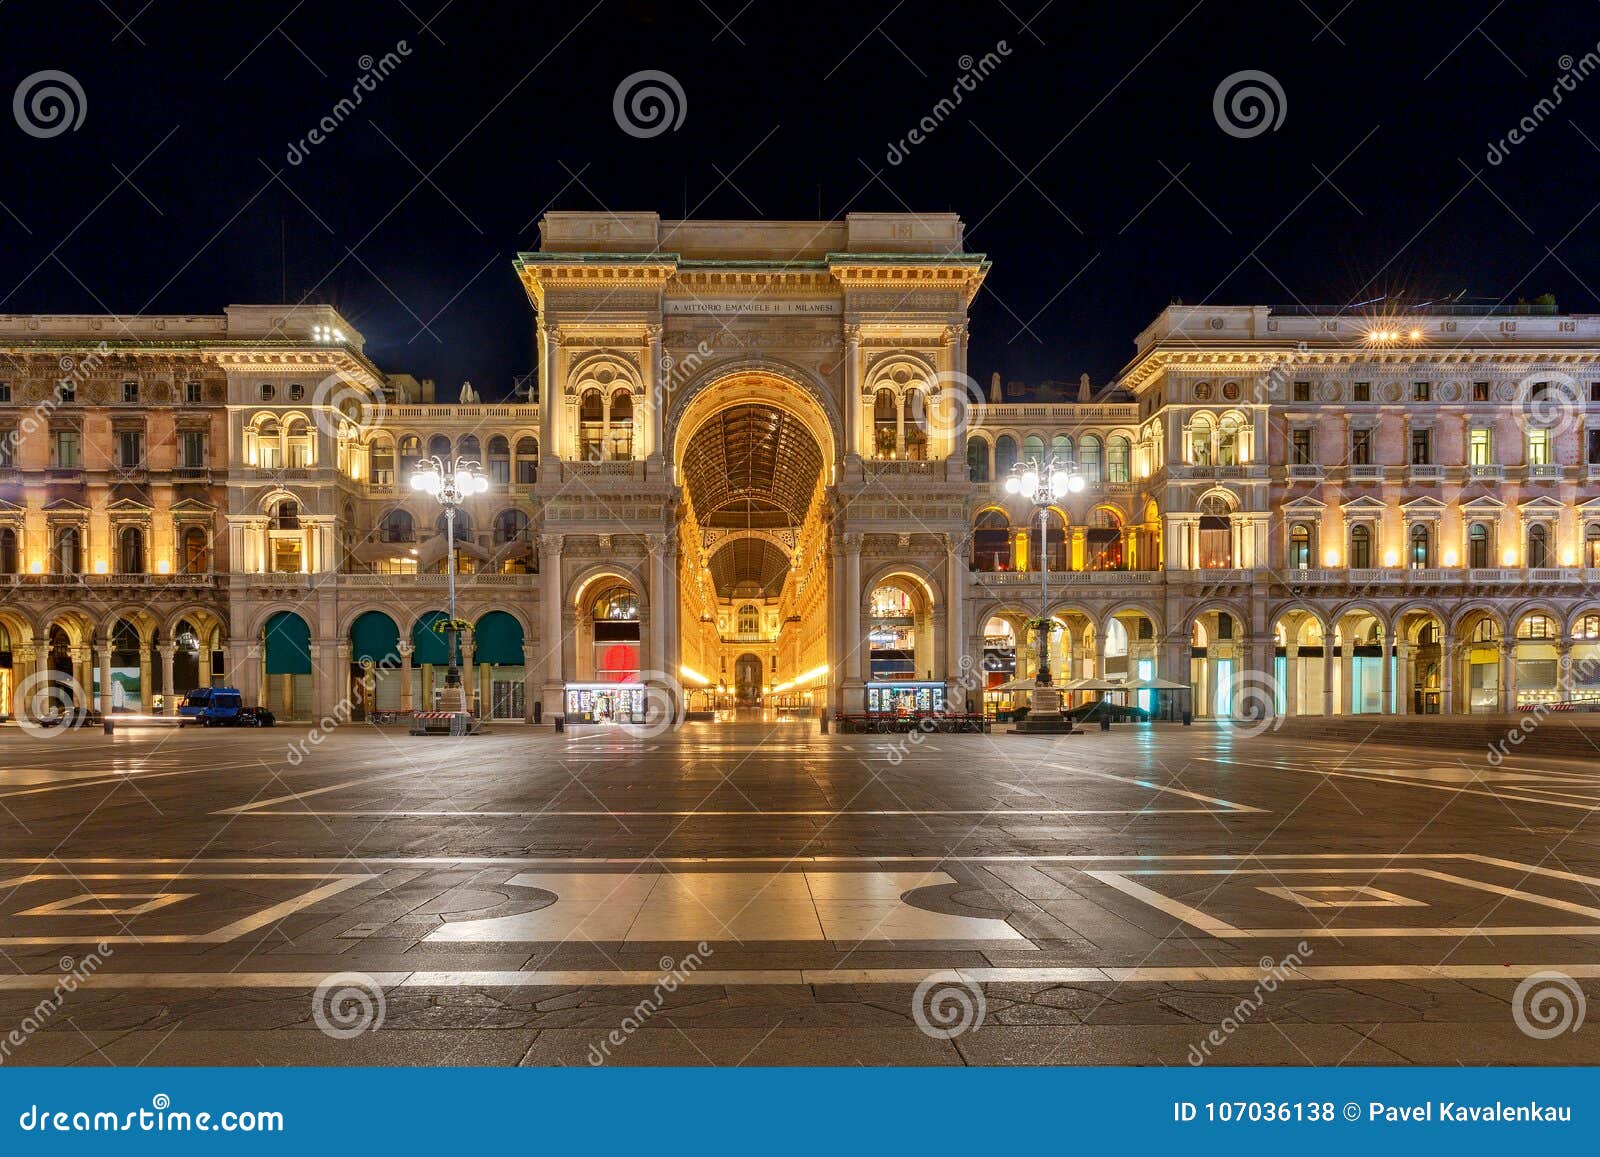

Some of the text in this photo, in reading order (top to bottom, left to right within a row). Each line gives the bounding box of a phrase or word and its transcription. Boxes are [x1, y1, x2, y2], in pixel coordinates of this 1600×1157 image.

[684, 304, 721, 312] VITTORIO
[726, 304, 770, 312] EMANUELE
[795, 304, 833, 312] MILANESI
